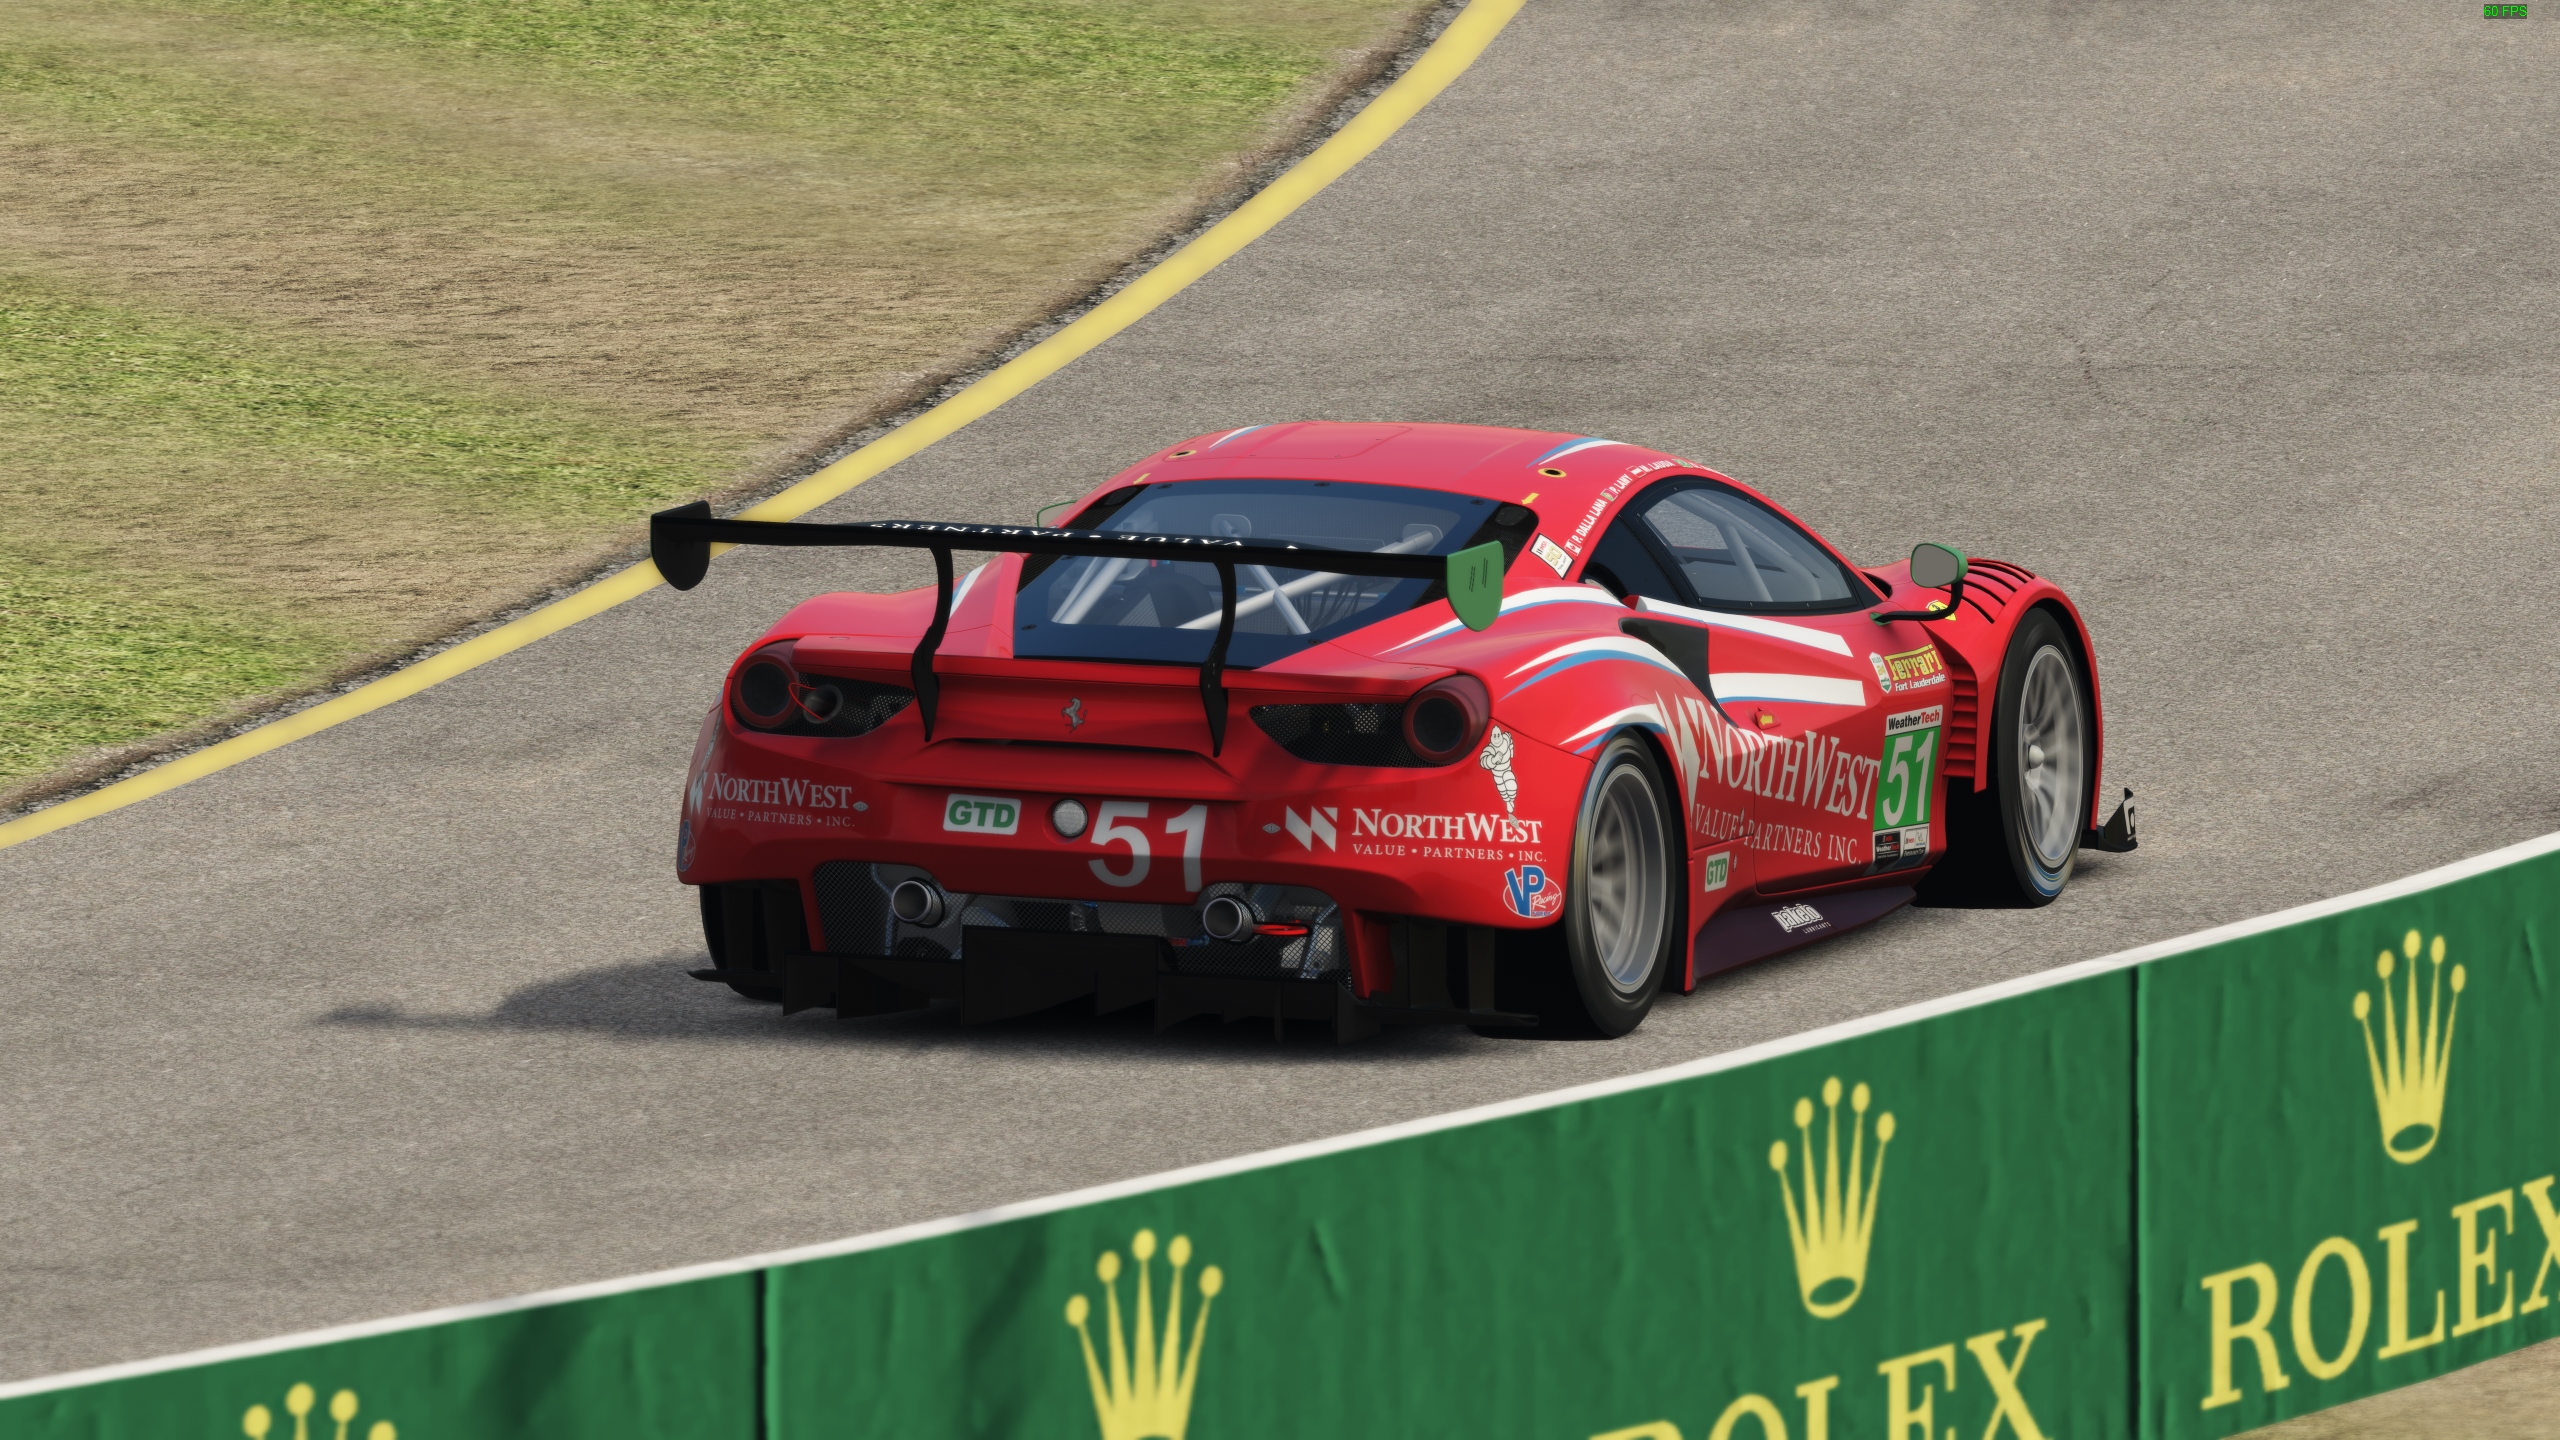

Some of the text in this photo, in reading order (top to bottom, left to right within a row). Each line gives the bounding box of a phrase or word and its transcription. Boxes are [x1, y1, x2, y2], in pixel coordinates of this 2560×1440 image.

[1571, 498, 1608, 544] P. DALLA LANA
[1884, 643, 1943, 681] Ferrari
[1894, 681, 1909, 692] Fort
[1909, 672, 1946, 689] Lauderdale
[1888, 708, 1940, 731] WeatherTech
[1882, 730, 1935, 826] 51
[706, 806, 855, 828] VALUE PARTNERS INC.
[947, 799, 1016, 830] GTD
[1087, 801, 1208, 893] 51
[1693, 803, 1863, 865] VALUE PARTNERS INC.
[1353, 843, 1547, 863] VALUE PARTNERS INC.
[1706, 859, 1728, 885] GTD
[1504, 864, 1546, 918] VP
[1532, 892, 1561, 910] Racing
